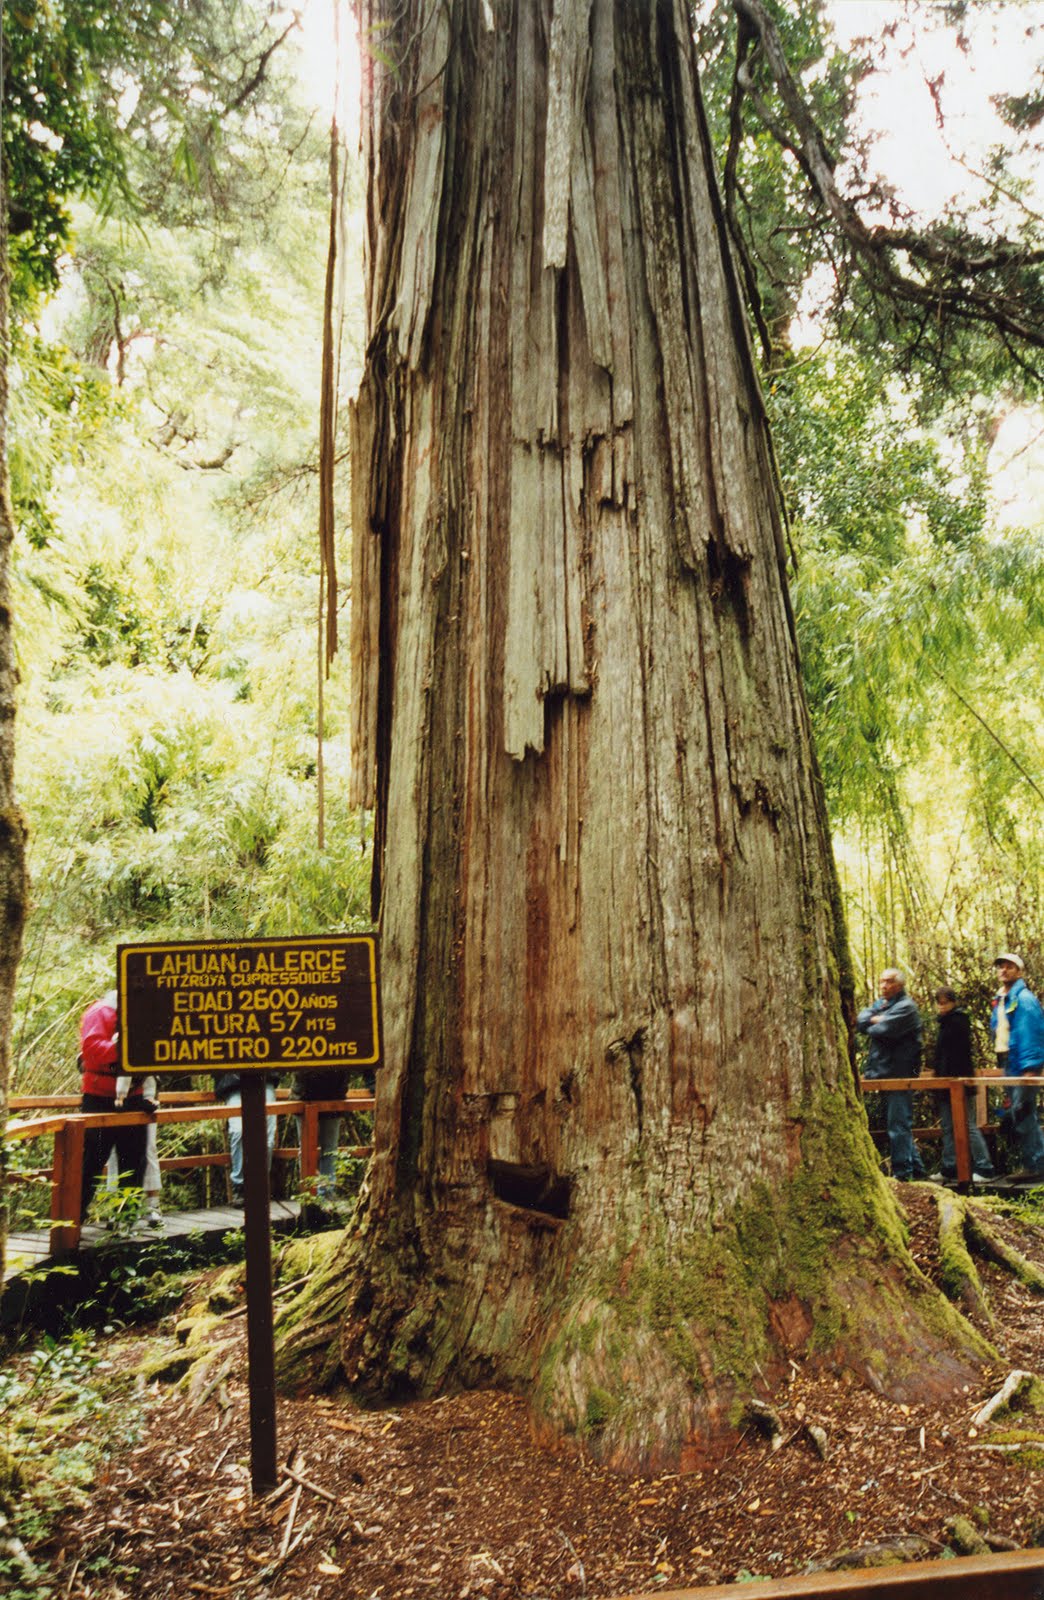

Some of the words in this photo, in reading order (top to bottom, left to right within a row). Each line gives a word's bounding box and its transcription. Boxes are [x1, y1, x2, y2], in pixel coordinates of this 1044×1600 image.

[146, 954, 237, 976] LAHUAN
[256, 950, 347, 972] ALERCE
[157, 973, 227, 988] FITZROYA
[231, 971, 341, 987] CUPRESSOIDES
[173, 991, 233, 1013] EDAD
[239, 988, 299, 1011] 2600
[300, 994, 338, 1009] AÑOS
[170, 1013, 260, 1036] ALTURA
[269, 1011, 303, 1033] 57
[306, 1017, 336, 1031] MTS
[154, 1037, 270, 1061] DIAMETRO
[281, 1036, 328, 1060] 220
[329, 1042, 358, 1056] MTS
